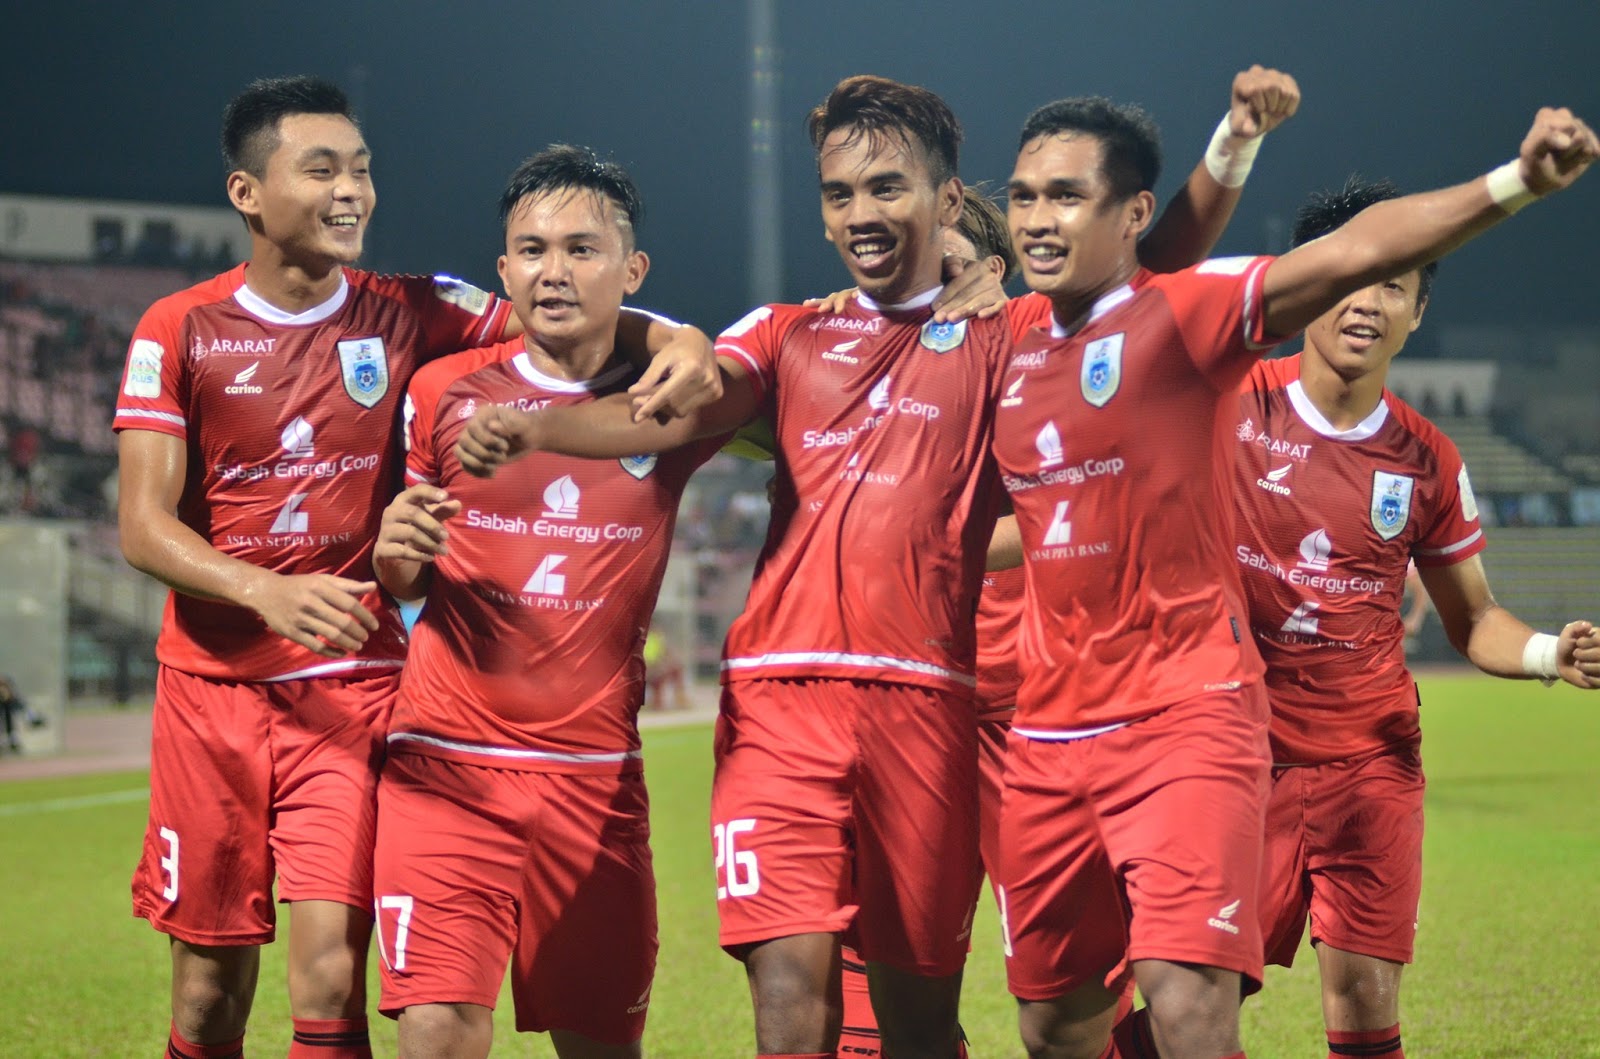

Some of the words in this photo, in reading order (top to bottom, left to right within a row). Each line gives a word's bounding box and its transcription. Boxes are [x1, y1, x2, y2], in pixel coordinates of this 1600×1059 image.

[824, 316, 883, 331] ARARAT
[211, 338, 276, 352] ARARAT
[821, 351, 859, 364] carino
[131, 374, 154, 384] PLUS
[224, 384, 263, 395] carino
[898, 397, 940, 420] Corp
[1256, 431, 1312, 458] ARARAT
[214, 463, 270, 480] Sabah
[274, 460, 336, 479] Energy
[341, 454, 378, 471] Corp
[1038, 466, 1085, 485] Energy
[1084, 457, 1124, 476] Corp
[865, 471, 898, 485] BASE
[1256, 478, 1291, 496] carino
[466, 509, 527, 535] Sabah
[532, 519, 600, 543] Energy
[603, 523, 643, 542] Corp
[225, 534, 263, 547] ASIAN
[265, 534, 315, 547] SUPPLY
[1078, 542, 1112, 557] BASE
[1236, 545, 1286, 580] Sabah
[1288, 568, 1346, 594] Energy
[1349, 576, 1384, 595] Corp
[518, 595, 570, 611] SUPPLY
[159, 826, 180, 902] 3
[713, 818, 761, 900] 26
